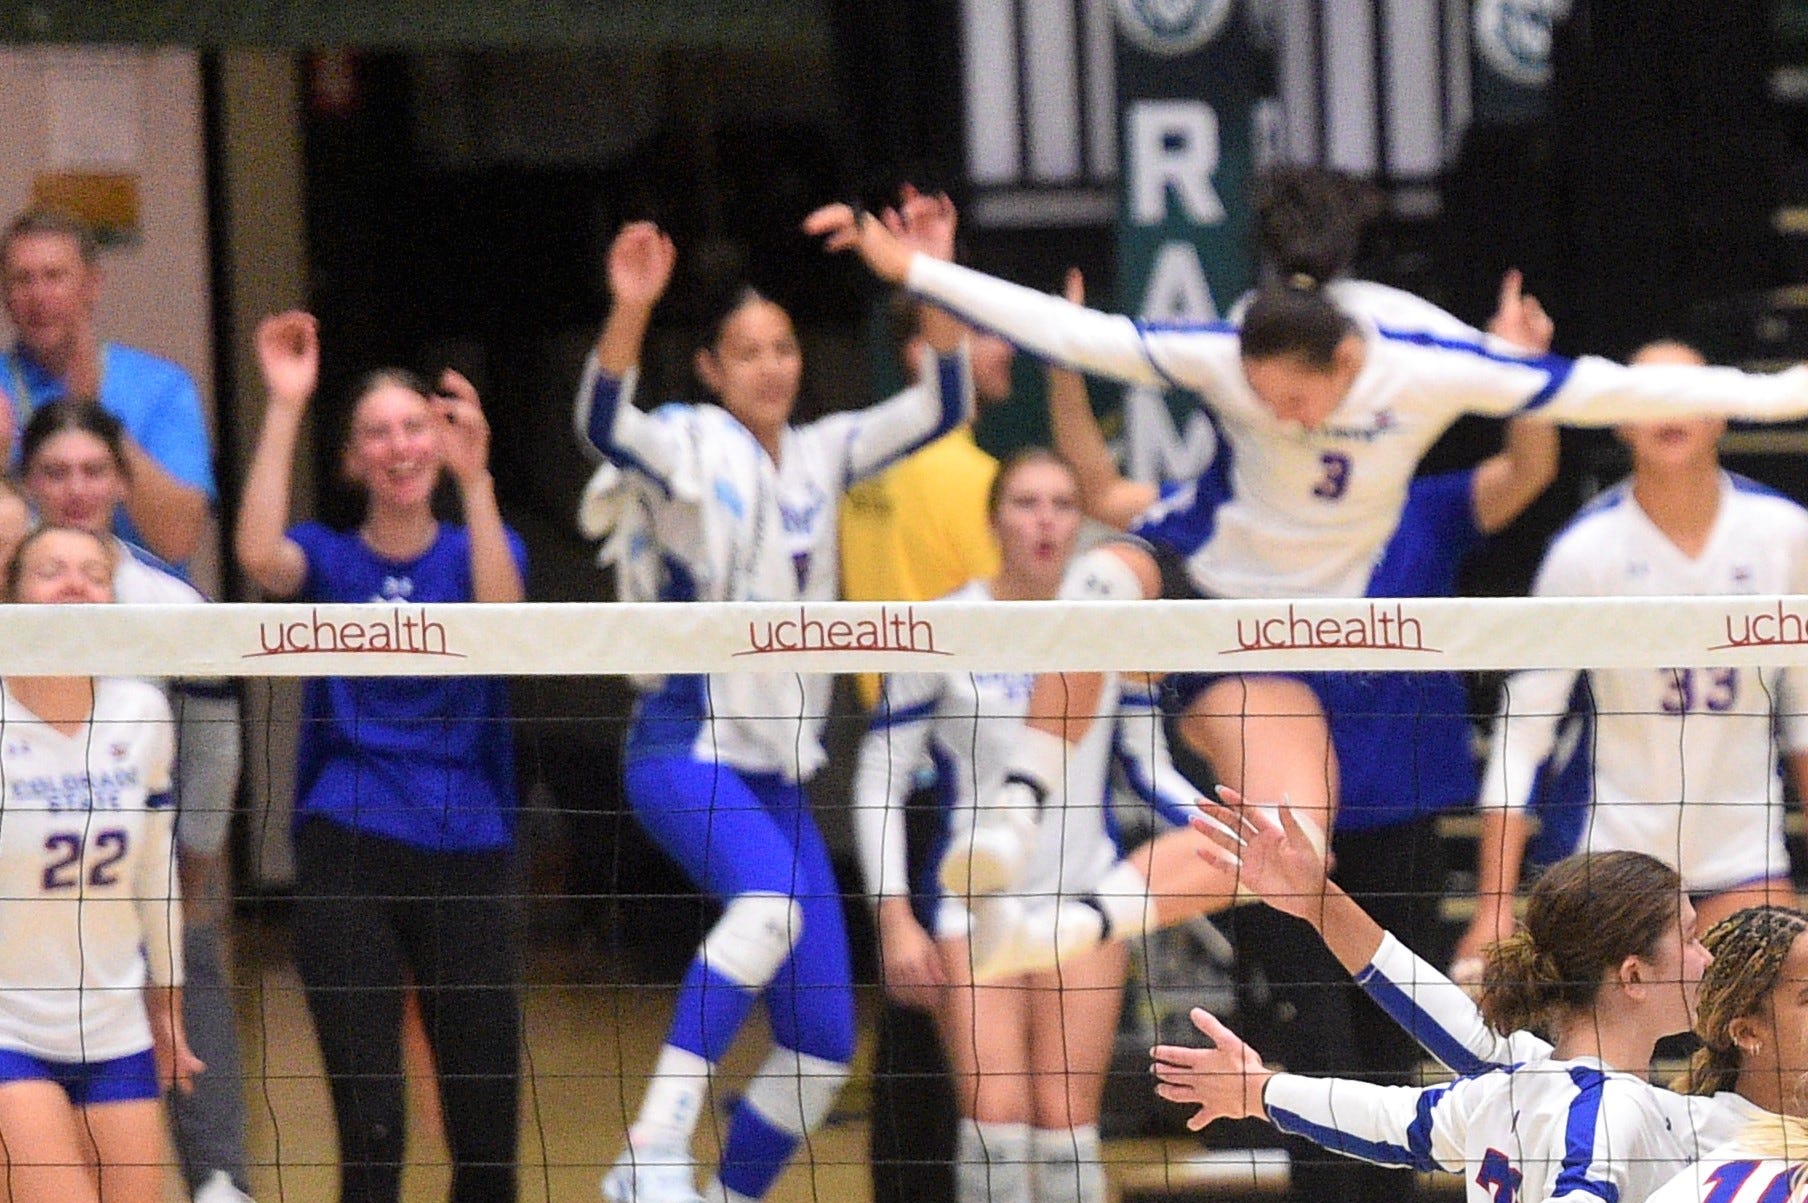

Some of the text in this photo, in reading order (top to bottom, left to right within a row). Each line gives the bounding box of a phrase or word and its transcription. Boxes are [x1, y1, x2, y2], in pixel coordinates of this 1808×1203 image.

[1313, 452, 1352, 499] 3
[260, 609, 446, 655] uchealth
[749, 607, 936, 653] uchealth
[1237, 604, 1423, 650] uchealth
[42, 829, 129, 890] 22
